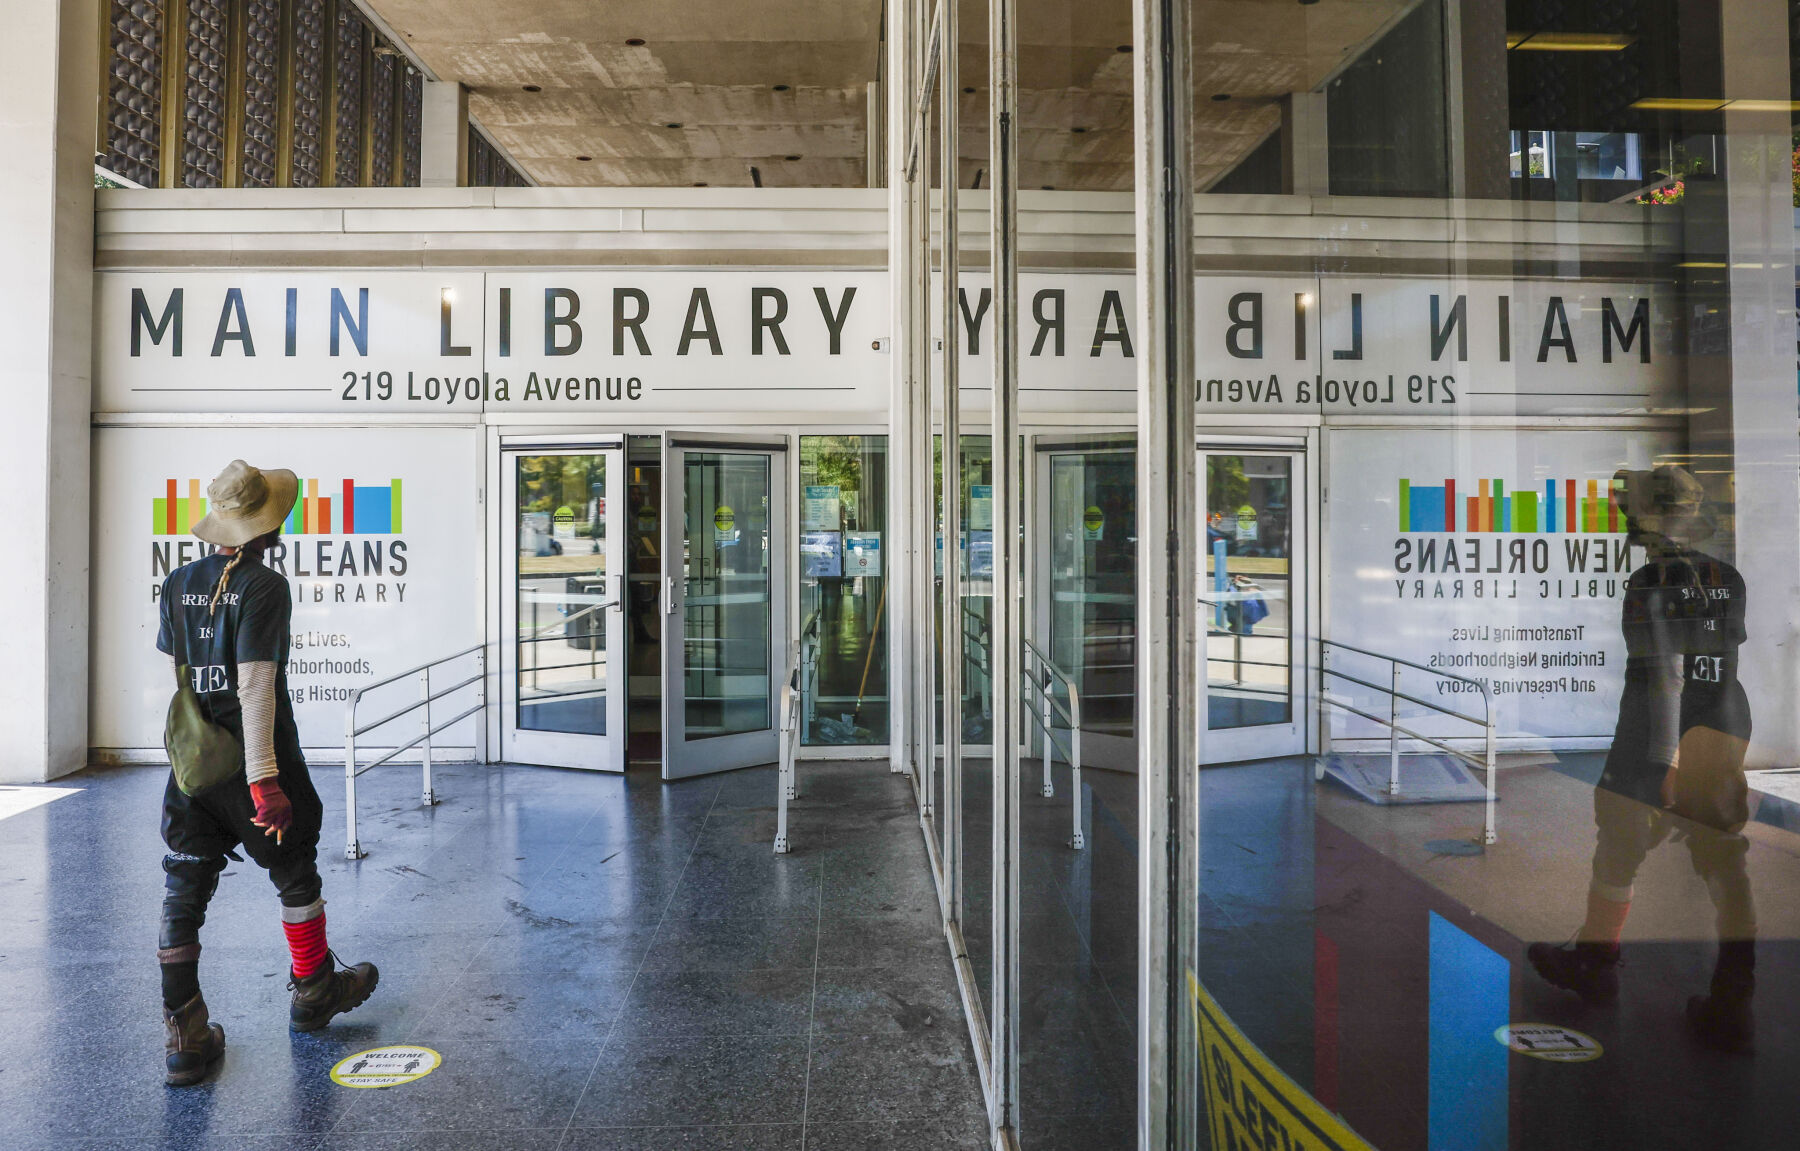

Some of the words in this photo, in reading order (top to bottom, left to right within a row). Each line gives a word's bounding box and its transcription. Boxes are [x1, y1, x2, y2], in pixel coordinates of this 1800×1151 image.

[131, 288, 369, 357] MAIN
[440, 287, 857, 358] LIBRARY
[342, 371, 393, 401] 219
[407, 371, 510, 405] Loyola
[523, 371, 642, 401] Avenue
[270, 540, 408, 577] RLEANS
[299, 583, 407, 603] IBRARY
[308, 631, 350, 648] Lives,
[285, 658, 374, 676] hborhoods,
[309, 685, 357, 702] Histor
